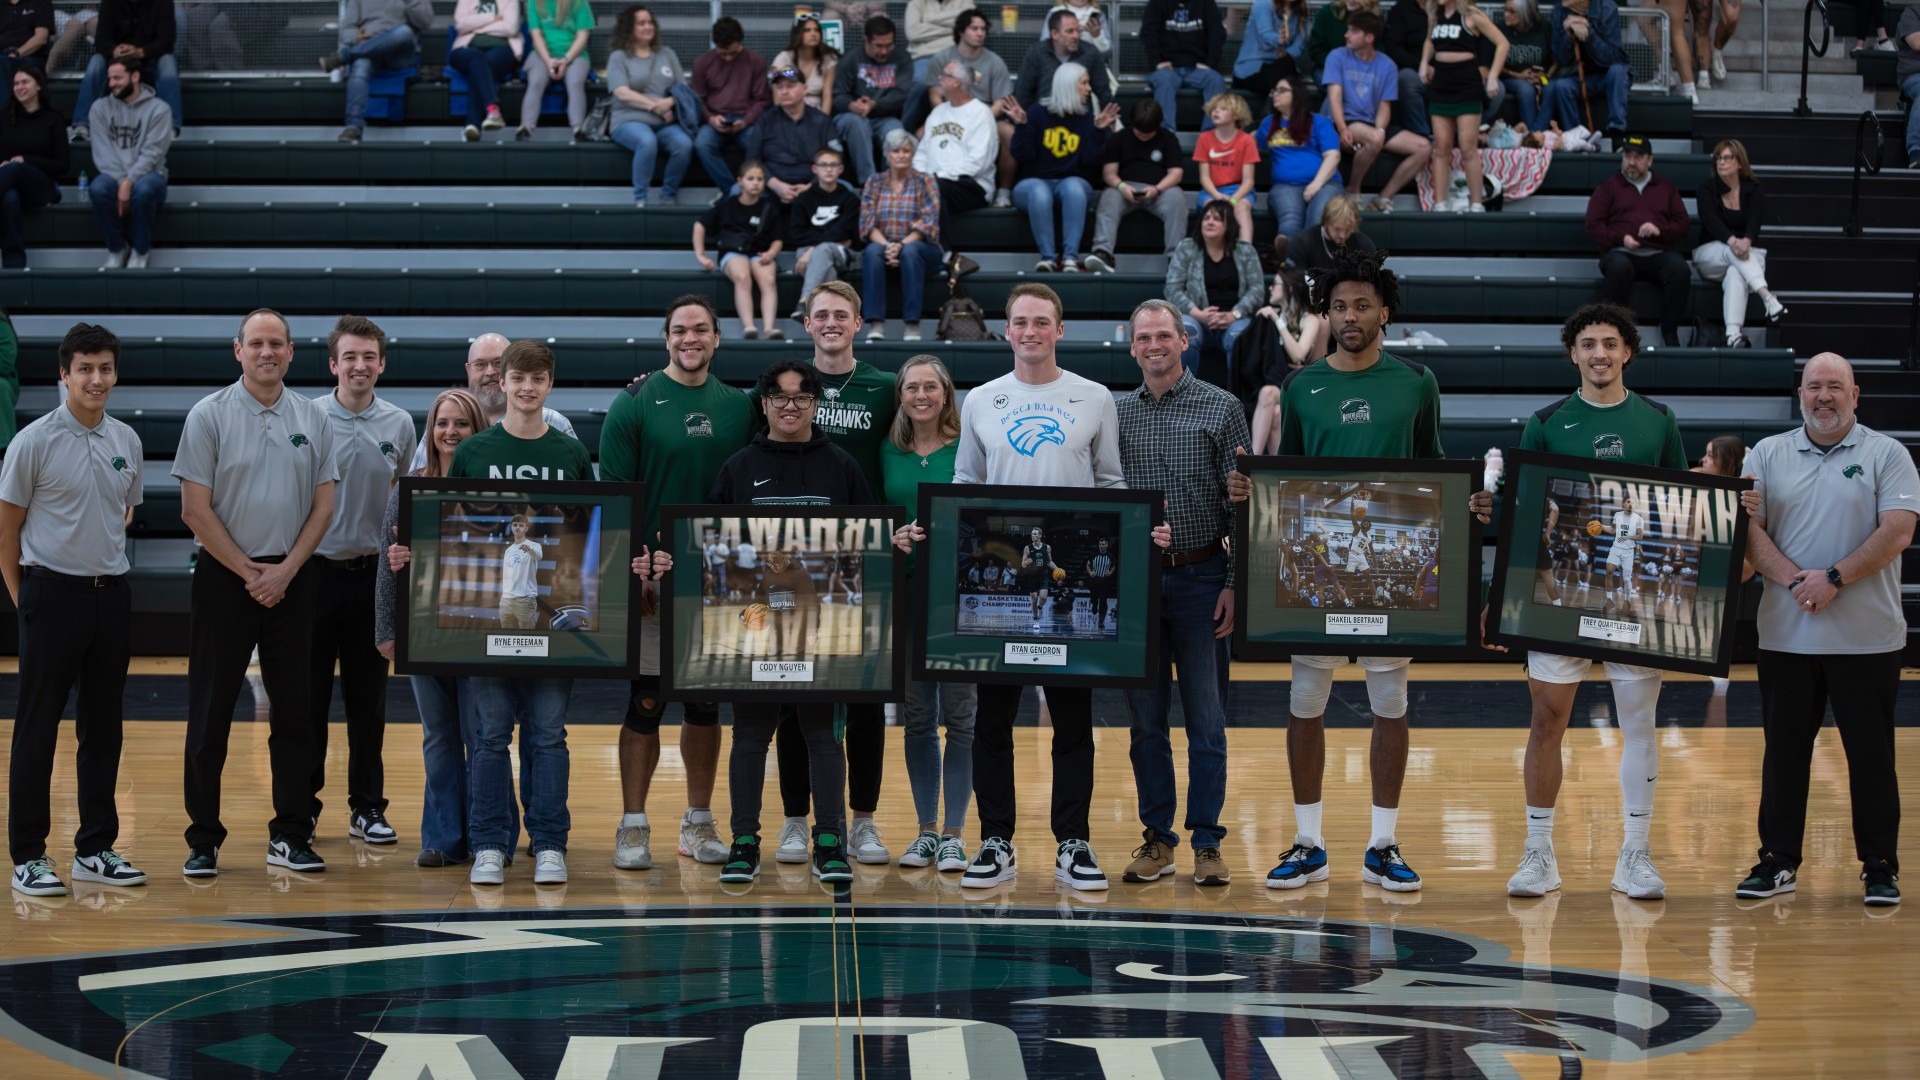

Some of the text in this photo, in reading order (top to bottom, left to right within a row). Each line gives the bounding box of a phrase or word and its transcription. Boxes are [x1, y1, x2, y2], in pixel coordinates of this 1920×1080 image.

[1431, 24, 1462, 39] NSU
[1042, 126, 1081, 158] UCO
[847, 402, 866, 410] STATE
[814, 407, 872, 430] RHAWKS
[1353, 616, 1384, 624] BERTRAND
[1583, 618, 1640, 632] TREY QUARTLEBAUM
[494, 638, 543, 646] RYNE FREEMAN
[1011, 645, 1061, 655] RYAN GENDRON
[760, 663, 807, 671] CODY NGUYEN
